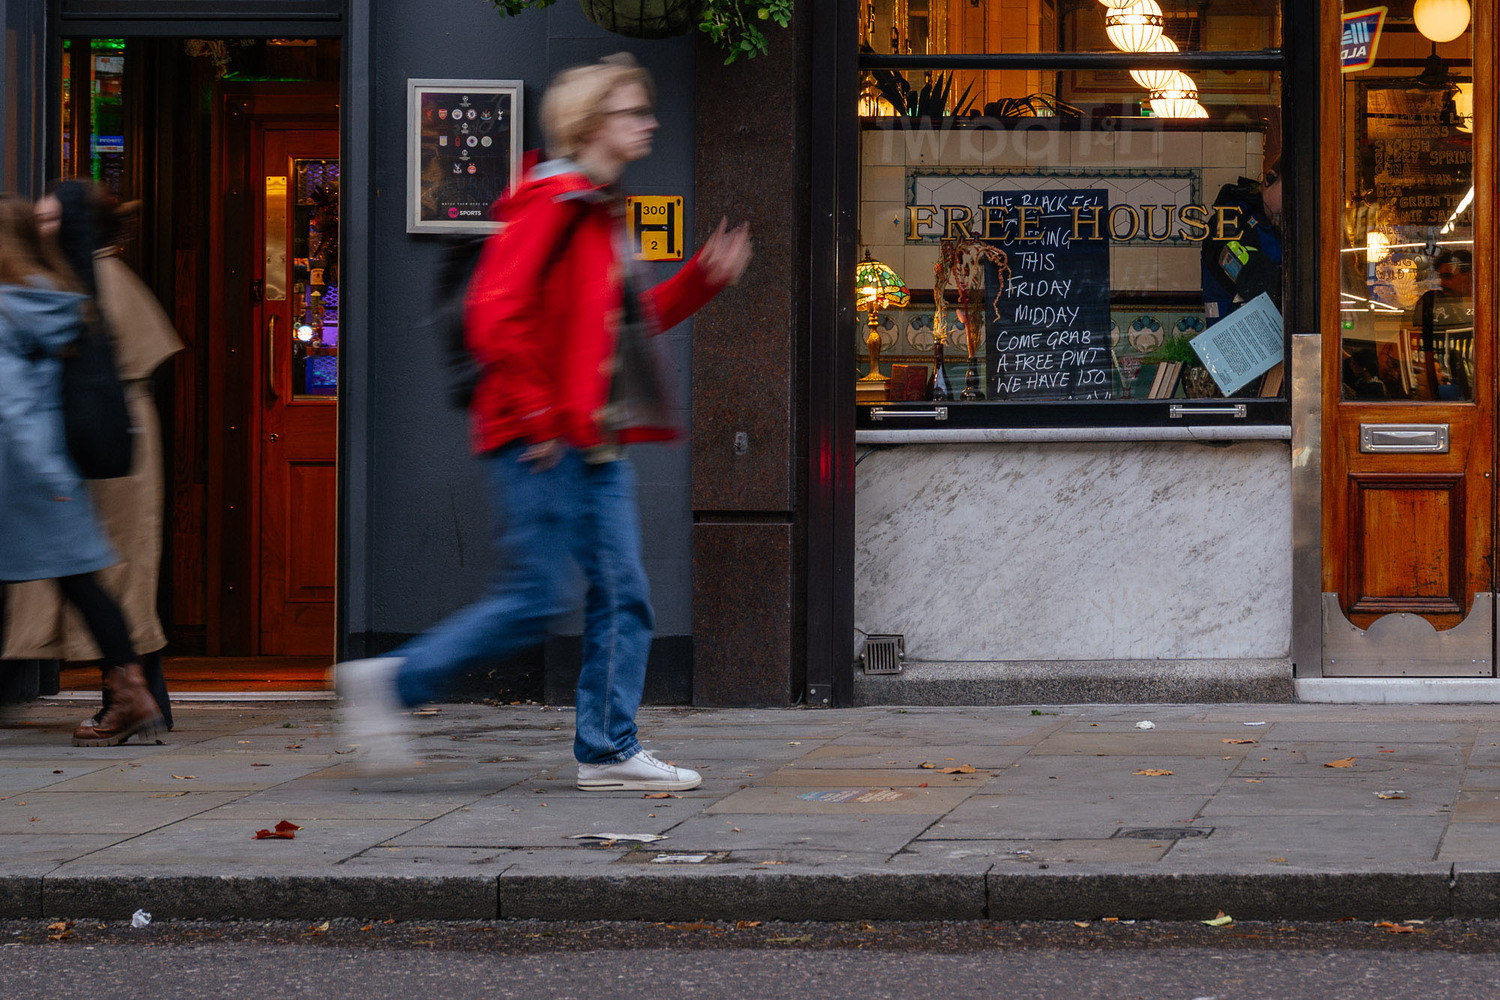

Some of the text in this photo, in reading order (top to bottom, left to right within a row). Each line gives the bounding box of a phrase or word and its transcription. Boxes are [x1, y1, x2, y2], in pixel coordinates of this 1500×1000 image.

[643, 206, 666, 215] 300
[906, 203, 1244, 242] FREE HOUSE
[651, 241, 658, 250] 2
[1015, 251, 1055, 272] THIS
[1005, 275, 1072, 299] FRIDAY
[1014, 304, 1080, 328] MIDDAY
[996, 330, 1091, 352] COME GRAB
[996, 347, 1106, 373] A FREE PINT
[997, 376, 1022, 393] WE
[1026, 371, 1071, 390] HAVE
